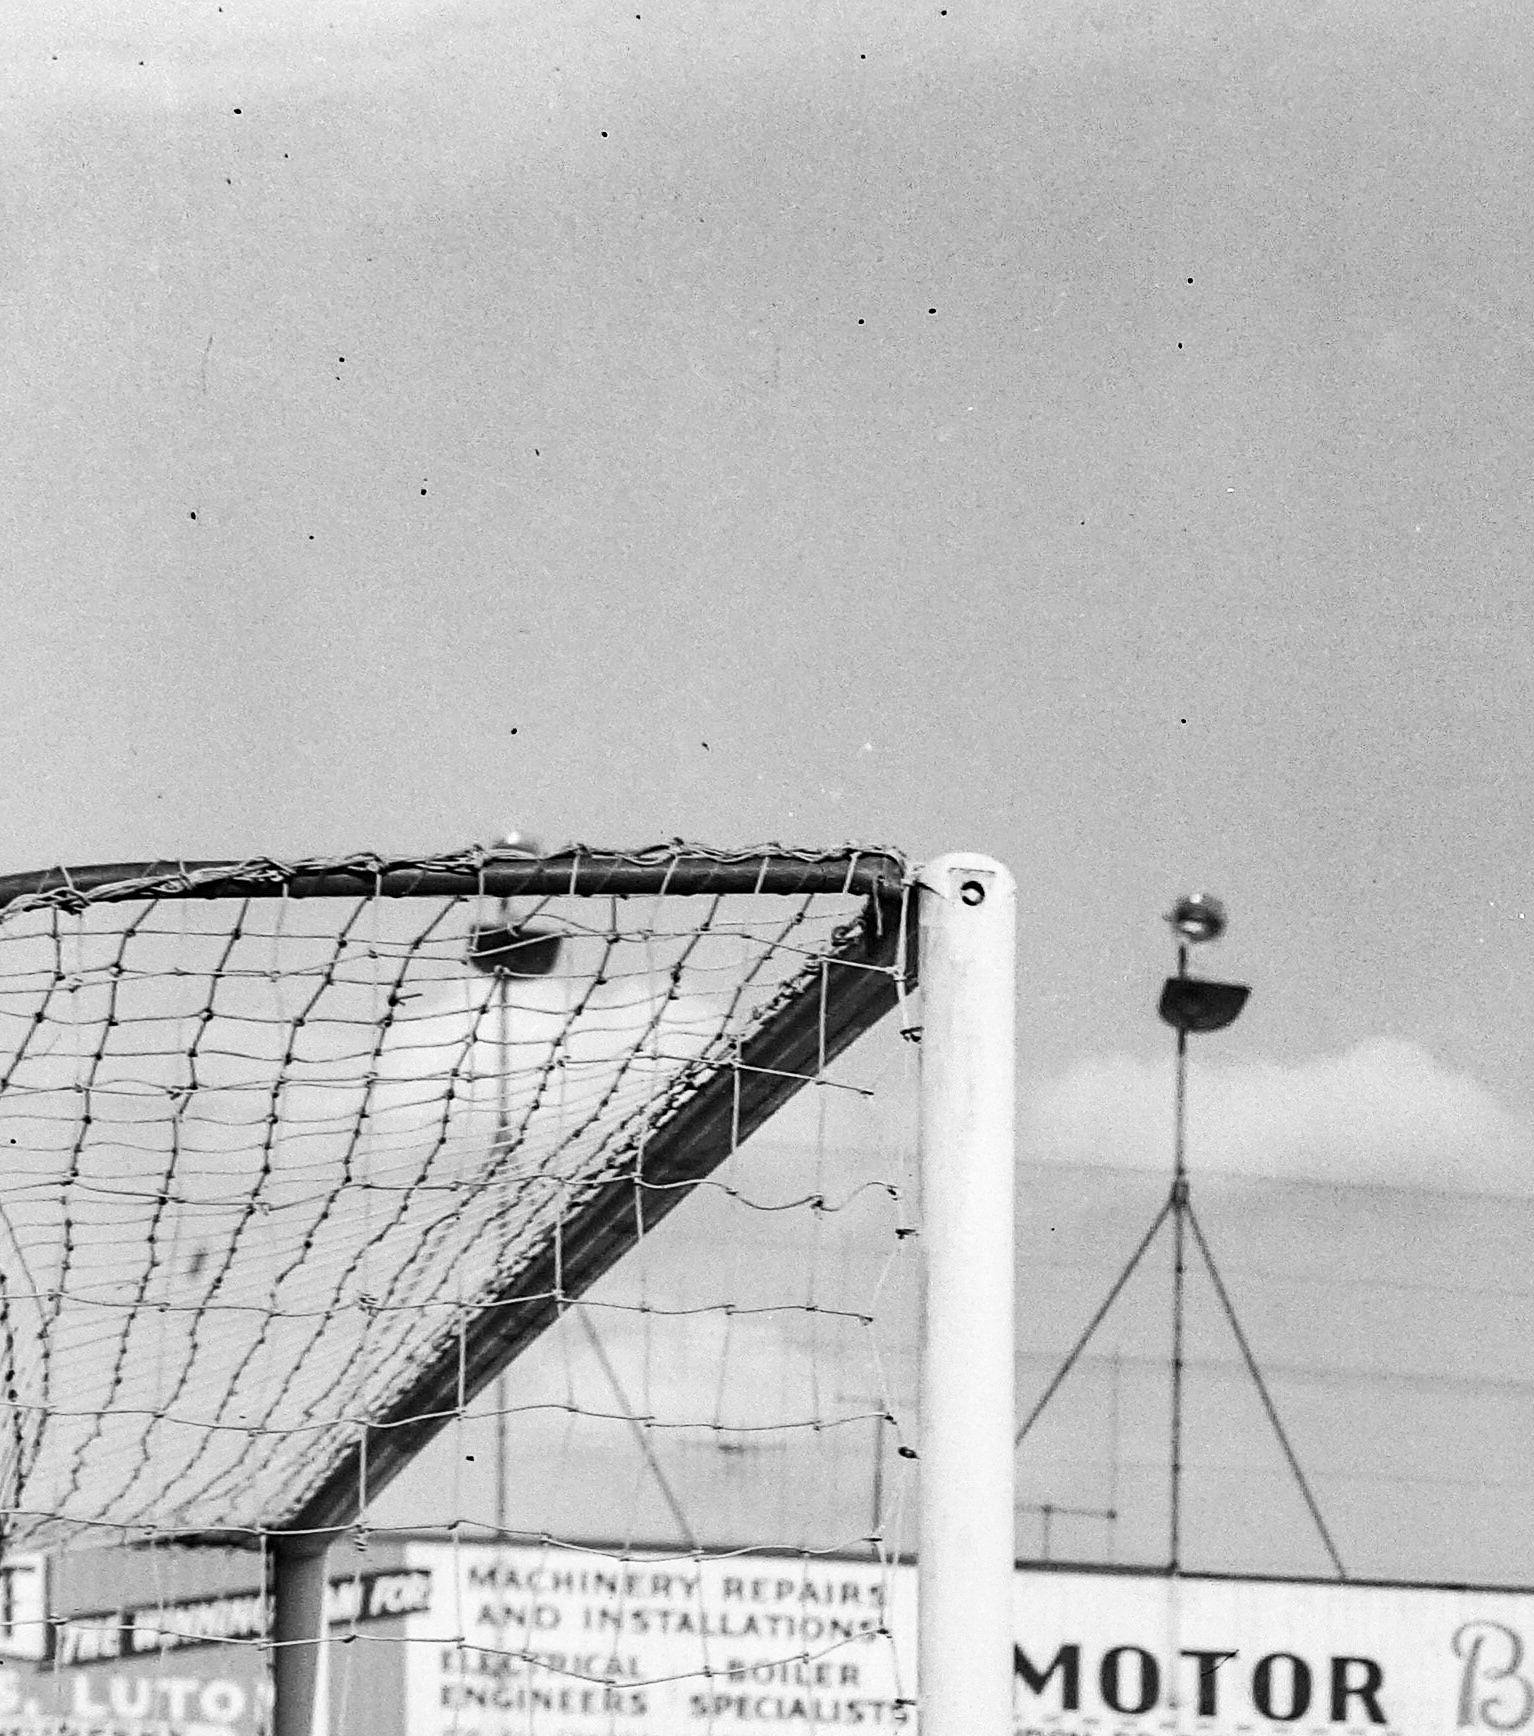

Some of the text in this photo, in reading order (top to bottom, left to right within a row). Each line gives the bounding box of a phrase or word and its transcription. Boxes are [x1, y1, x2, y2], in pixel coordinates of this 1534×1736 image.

[468, 1566, 886, 1609] MACHINERY REPAIRS
[475, 1604, 878, 1644] AND INSTALLATIONS
[440, 1648, 641, 1678] ELECTRICAL
[727, 1656, 860, 1688] BOILER
[1014, 1642, 1388, 1724] MOTOR
[440, 1684, 649, 1716] ENGINEERS
[689, 1694, 908, 1725] SPECIALISTS
